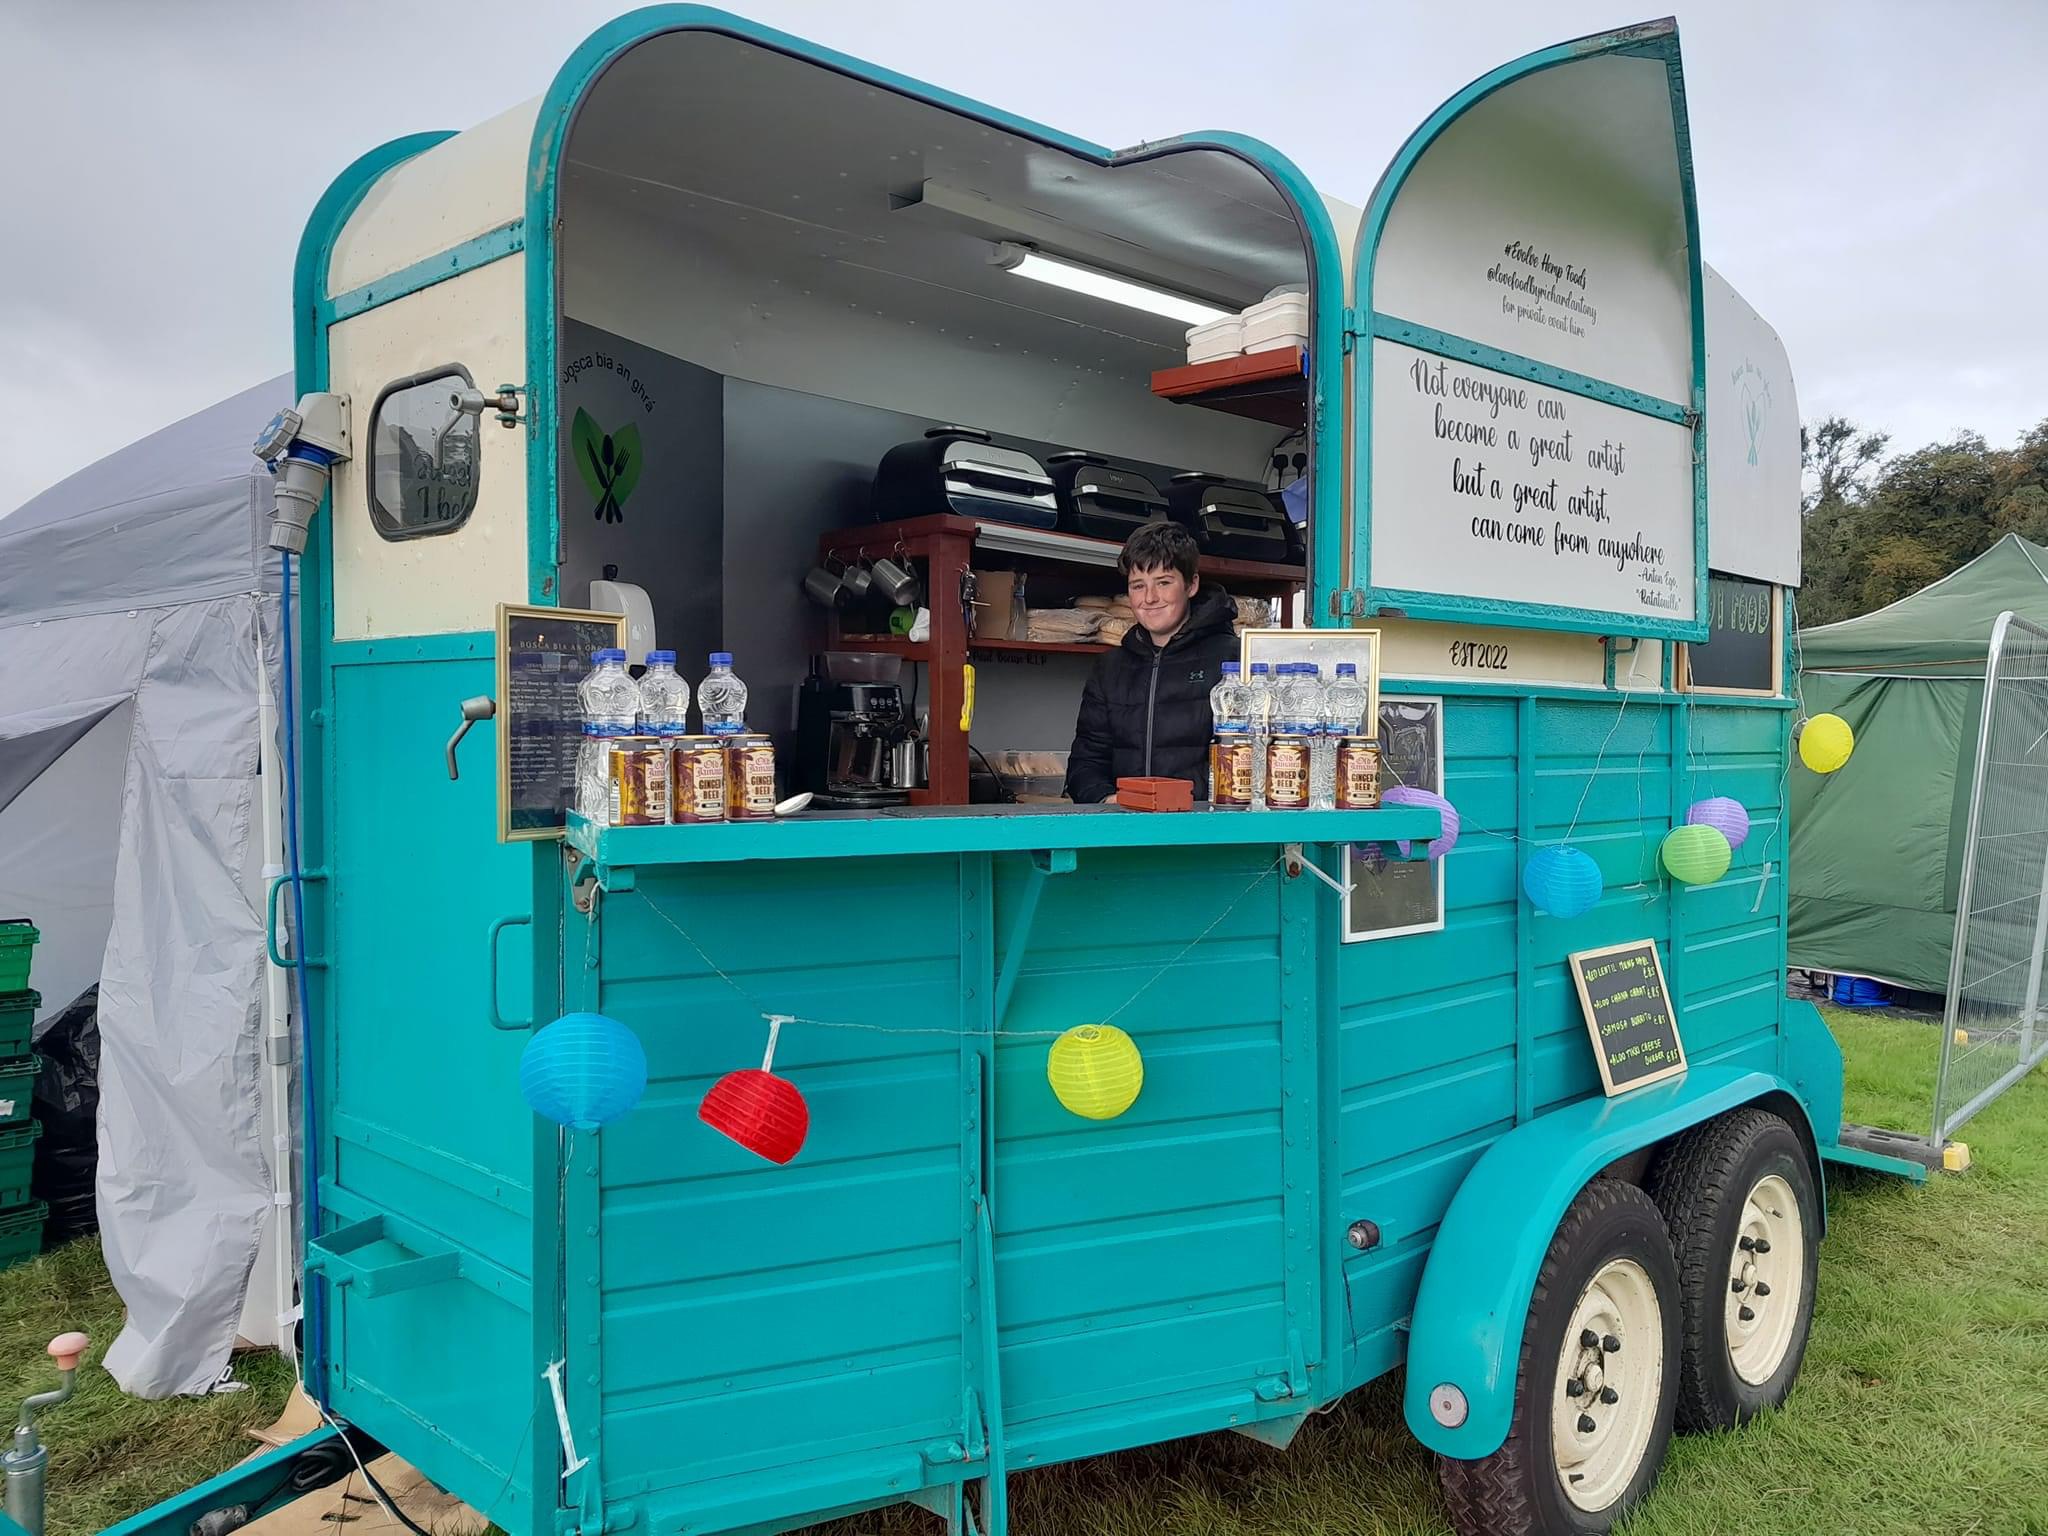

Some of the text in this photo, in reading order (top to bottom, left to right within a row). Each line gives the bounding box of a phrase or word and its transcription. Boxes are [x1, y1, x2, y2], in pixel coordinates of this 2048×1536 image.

[1504, 241, 1539, 268] #Evolve
[1541, 253, 1563, 283] Hemp
[1502, 295, 1586, 338] for private event hire
[596, 352, 614, 370] bia
[616, 363, 631, 382] an
[630, 379, 656, 413] ghrá
[1410, 358, 1567, 421] Not everyone can
[1435, 402, 1626, 476] become a great artist
[1453, 457, 1611, 524] but a great artist,
[1472, 515, 1665, 571] can come from anywhere
[703, 789, 720, 800] BEER
[755, 785, 770, 795] BEER
[1274, 771, 1297, 780] GINGER
[1277, 779, 1294, 788] BEER
[1351, 773, 1375, 783] GINGER
[1354, 782, 1372, 791] BEER
